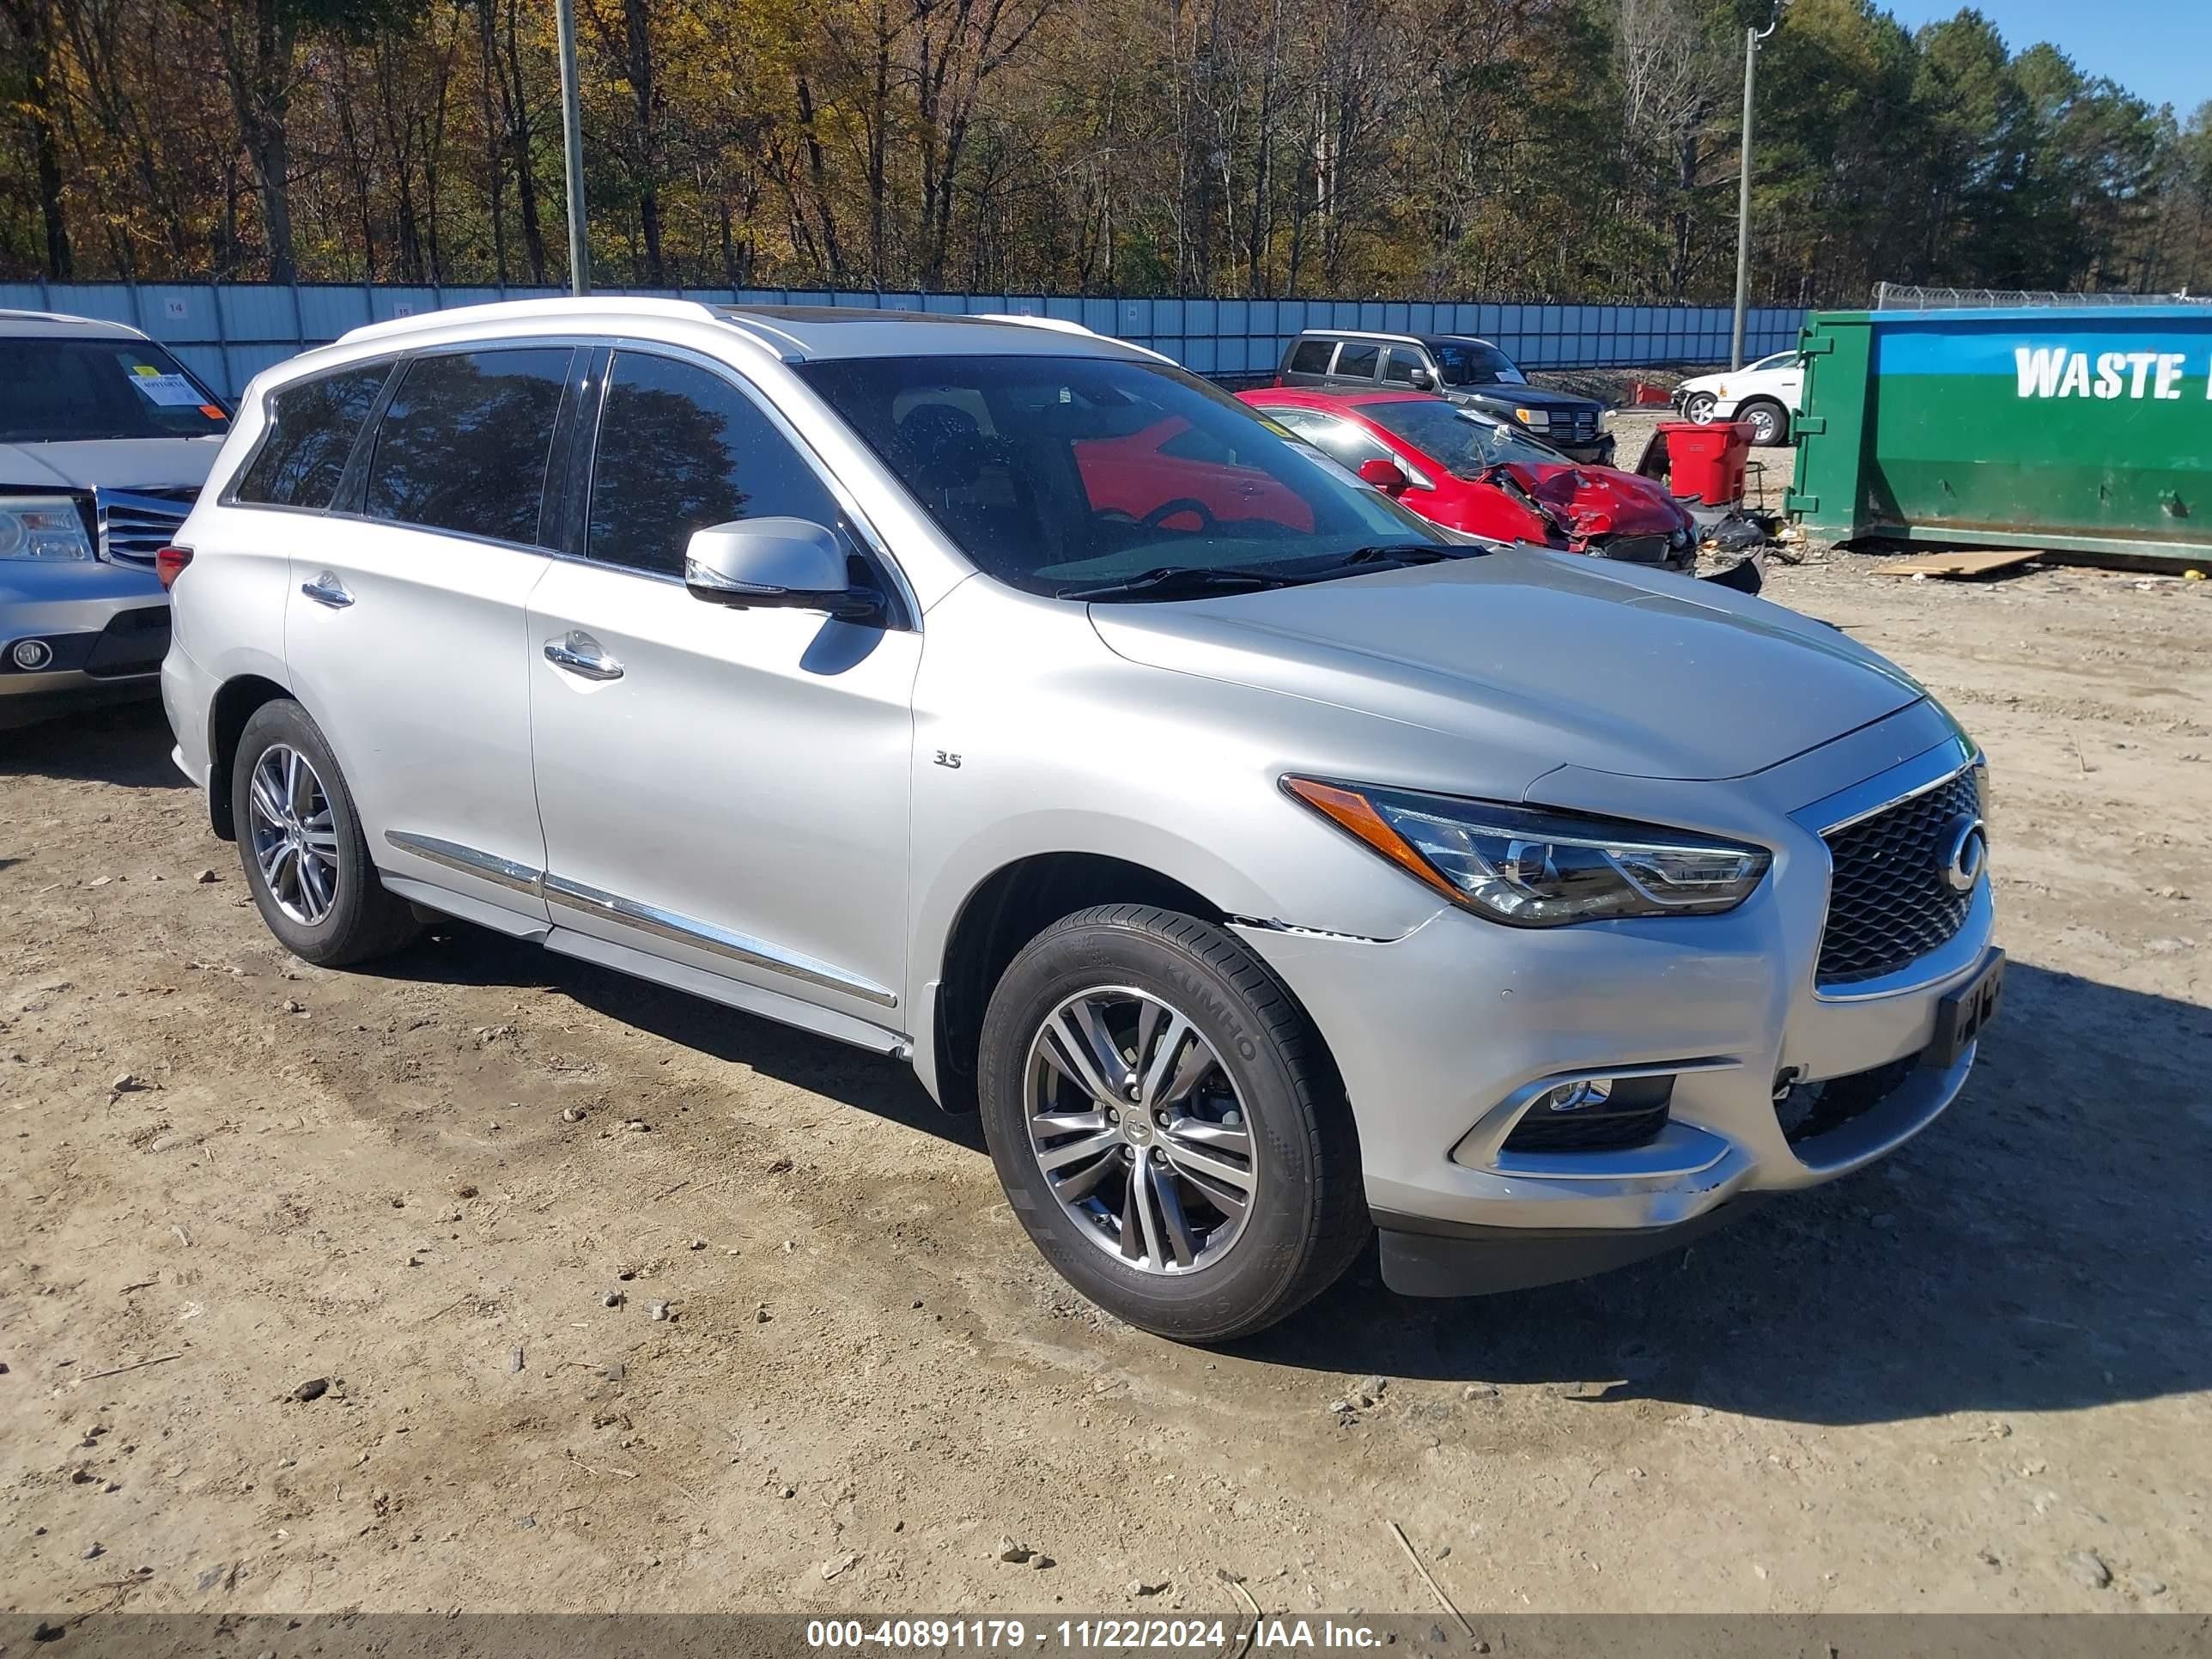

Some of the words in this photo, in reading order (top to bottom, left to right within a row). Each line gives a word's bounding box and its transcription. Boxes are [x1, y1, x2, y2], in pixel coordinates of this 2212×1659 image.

[169, 304, 183, 313] 14
[2014, 347, 2185, 400] WASTE
[1163, 961, 1257, 1061] KUMHO
